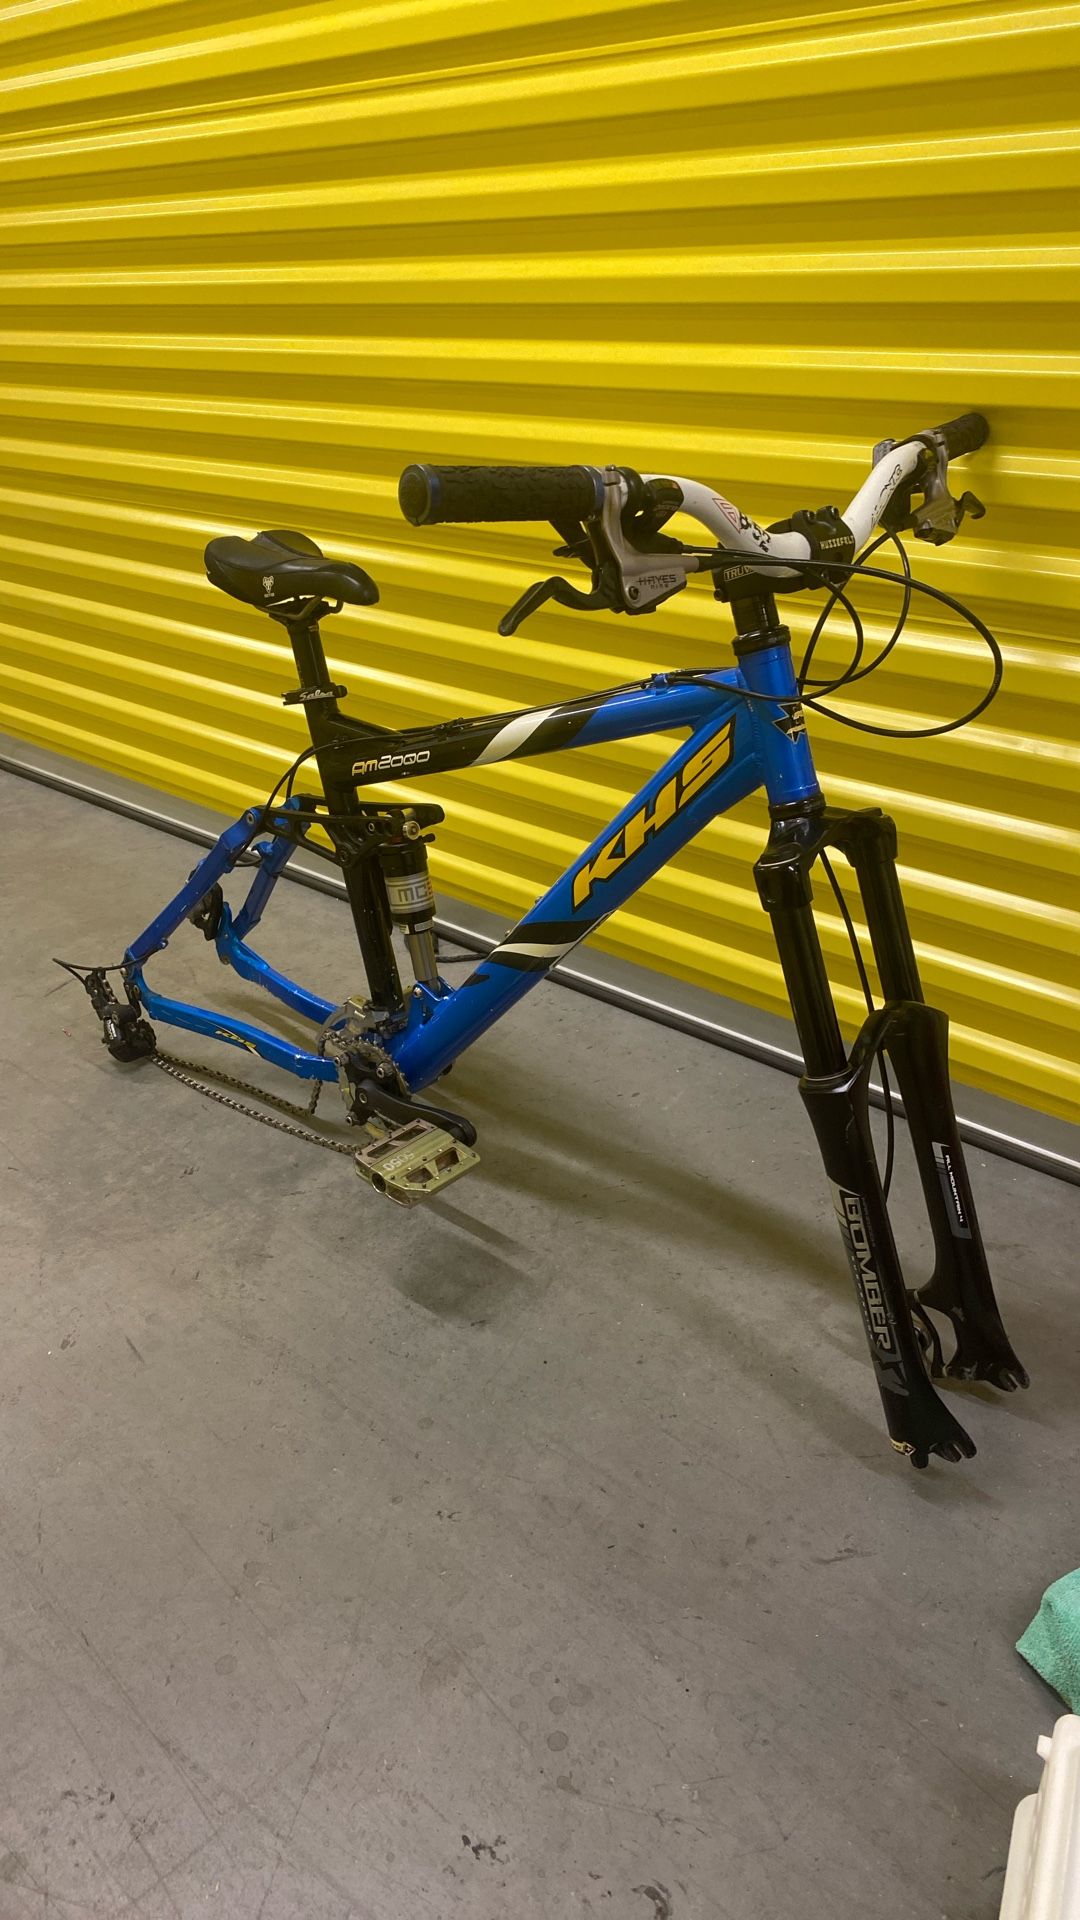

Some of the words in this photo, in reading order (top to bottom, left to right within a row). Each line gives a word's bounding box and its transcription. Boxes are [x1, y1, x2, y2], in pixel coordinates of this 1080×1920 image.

[636, 574, 677, 586] HAYES
[300, 688, 334, 701] Salsa
[573, 714, 735, 914] KHS
[844, 1196, 892, 1351] BOMBER
